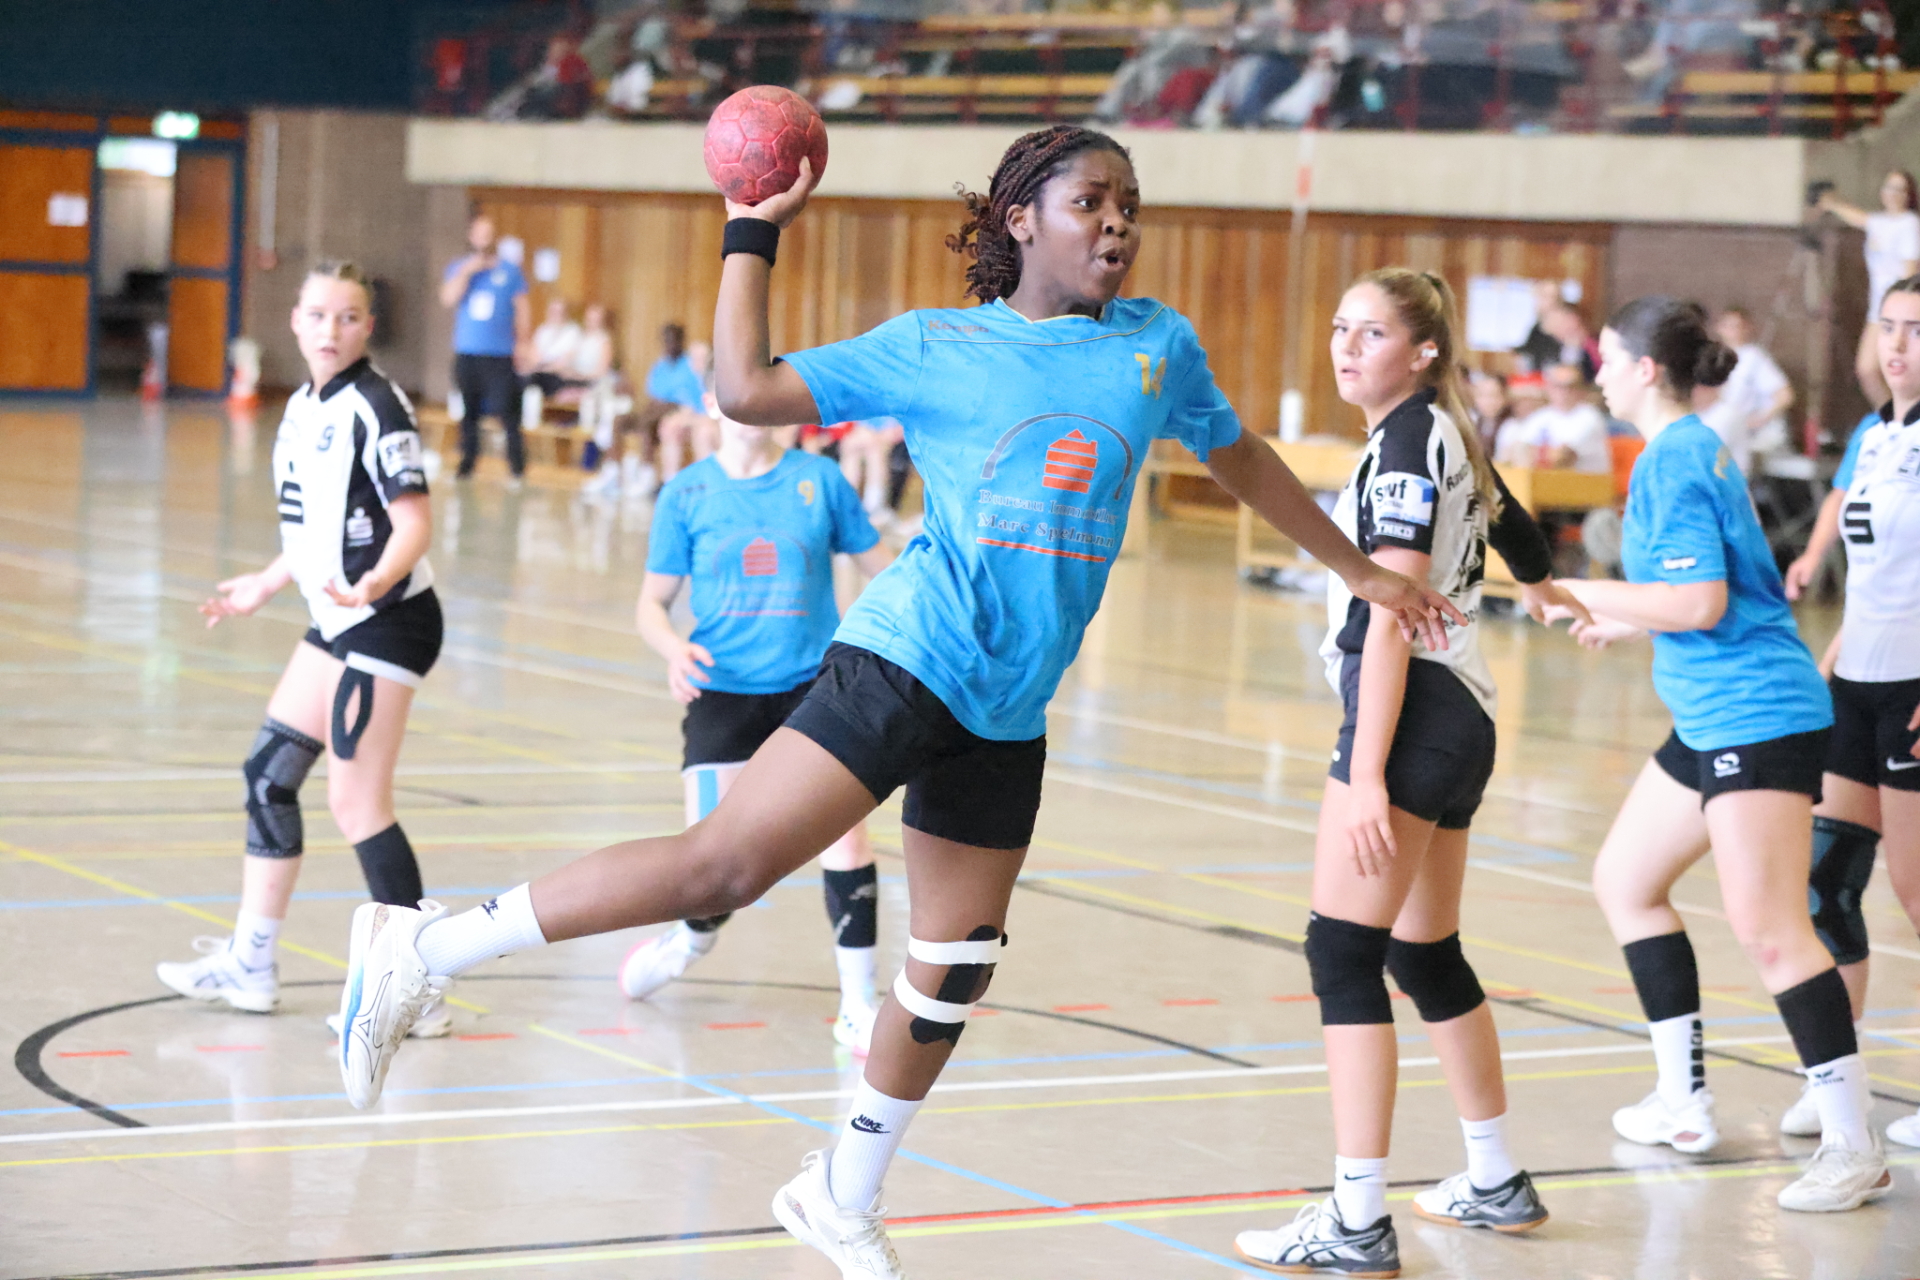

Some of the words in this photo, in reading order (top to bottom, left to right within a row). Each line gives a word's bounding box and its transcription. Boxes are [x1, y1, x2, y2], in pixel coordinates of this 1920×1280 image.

[797, 480, 815, 506] 9
[977, 512, 1030, 533] Marc
[857, 1113, 884, 1131] NIKE
